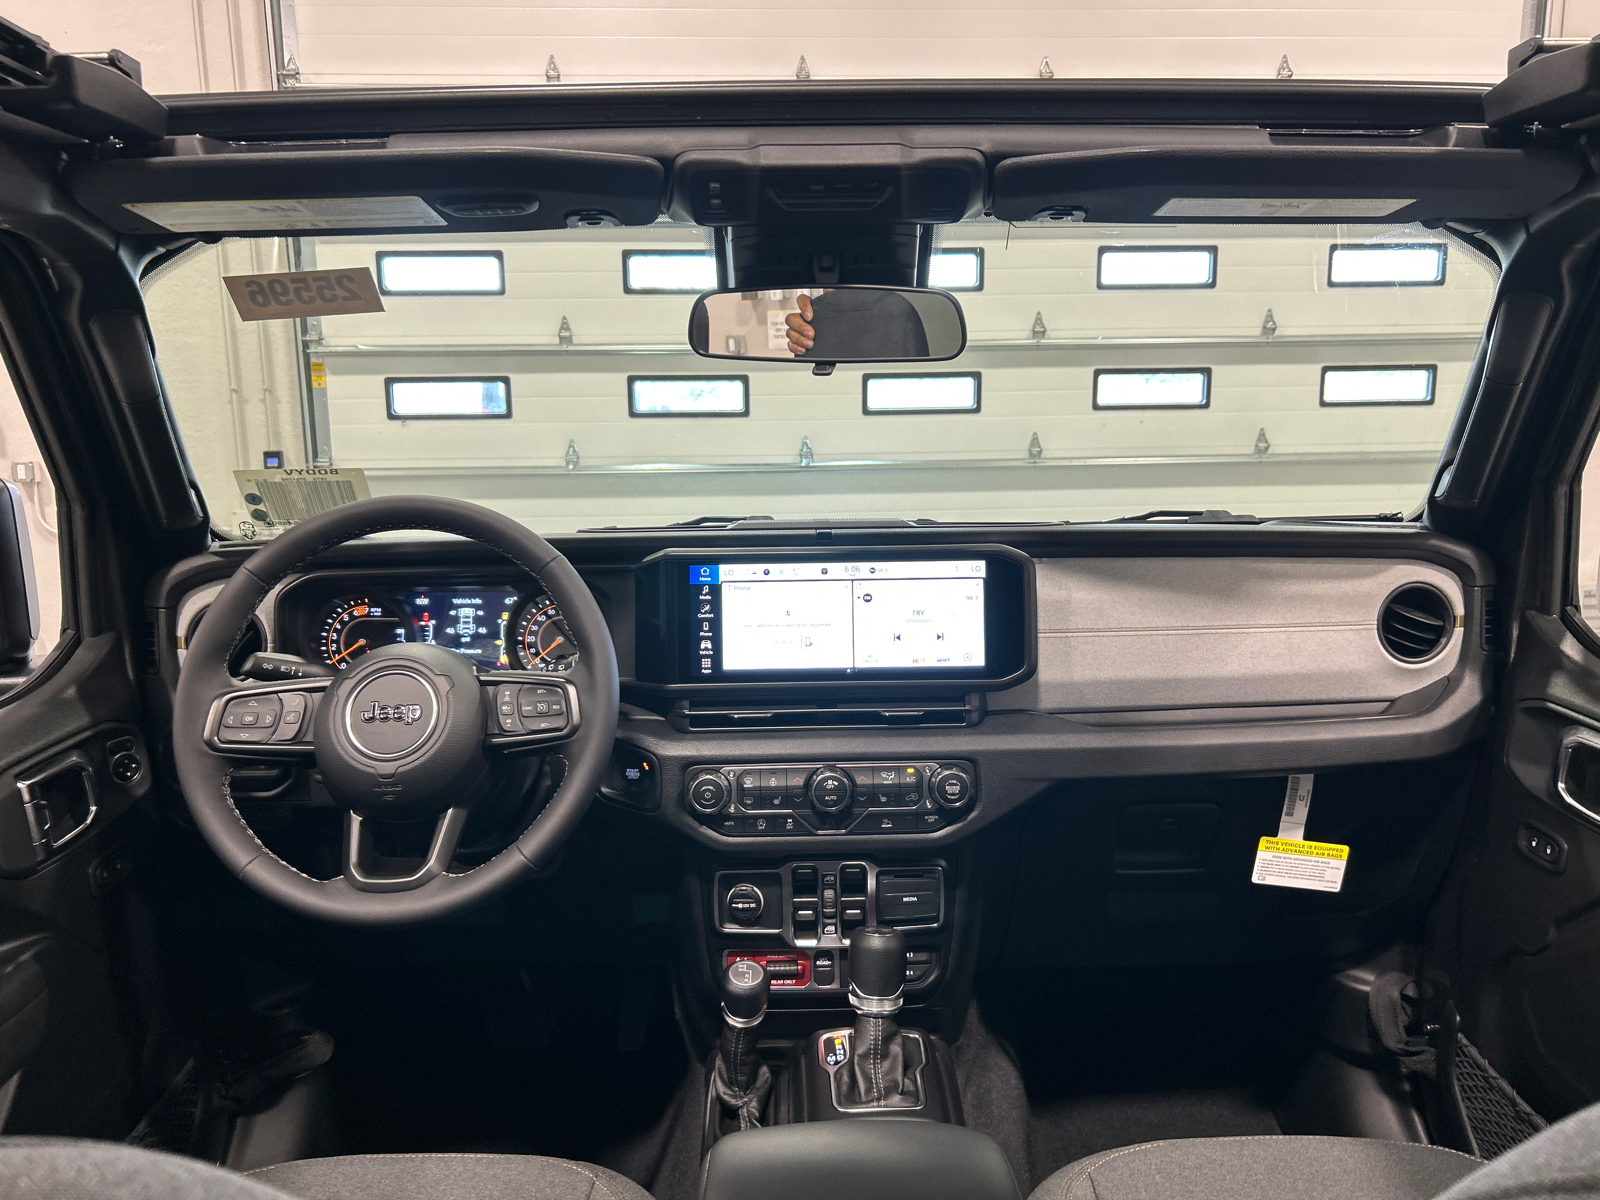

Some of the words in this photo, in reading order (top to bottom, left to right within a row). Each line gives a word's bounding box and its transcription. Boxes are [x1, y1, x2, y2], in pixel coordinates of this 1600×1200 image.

[844, 565, 861, 573] 606
[360, 700, 423, 725] Jeep
[1280, 841, 1305, 849] VEHICLE
[1314, 845, 1344, 853] EQUIPPED
[1281, 847, 1314, 855] ADVANCED
